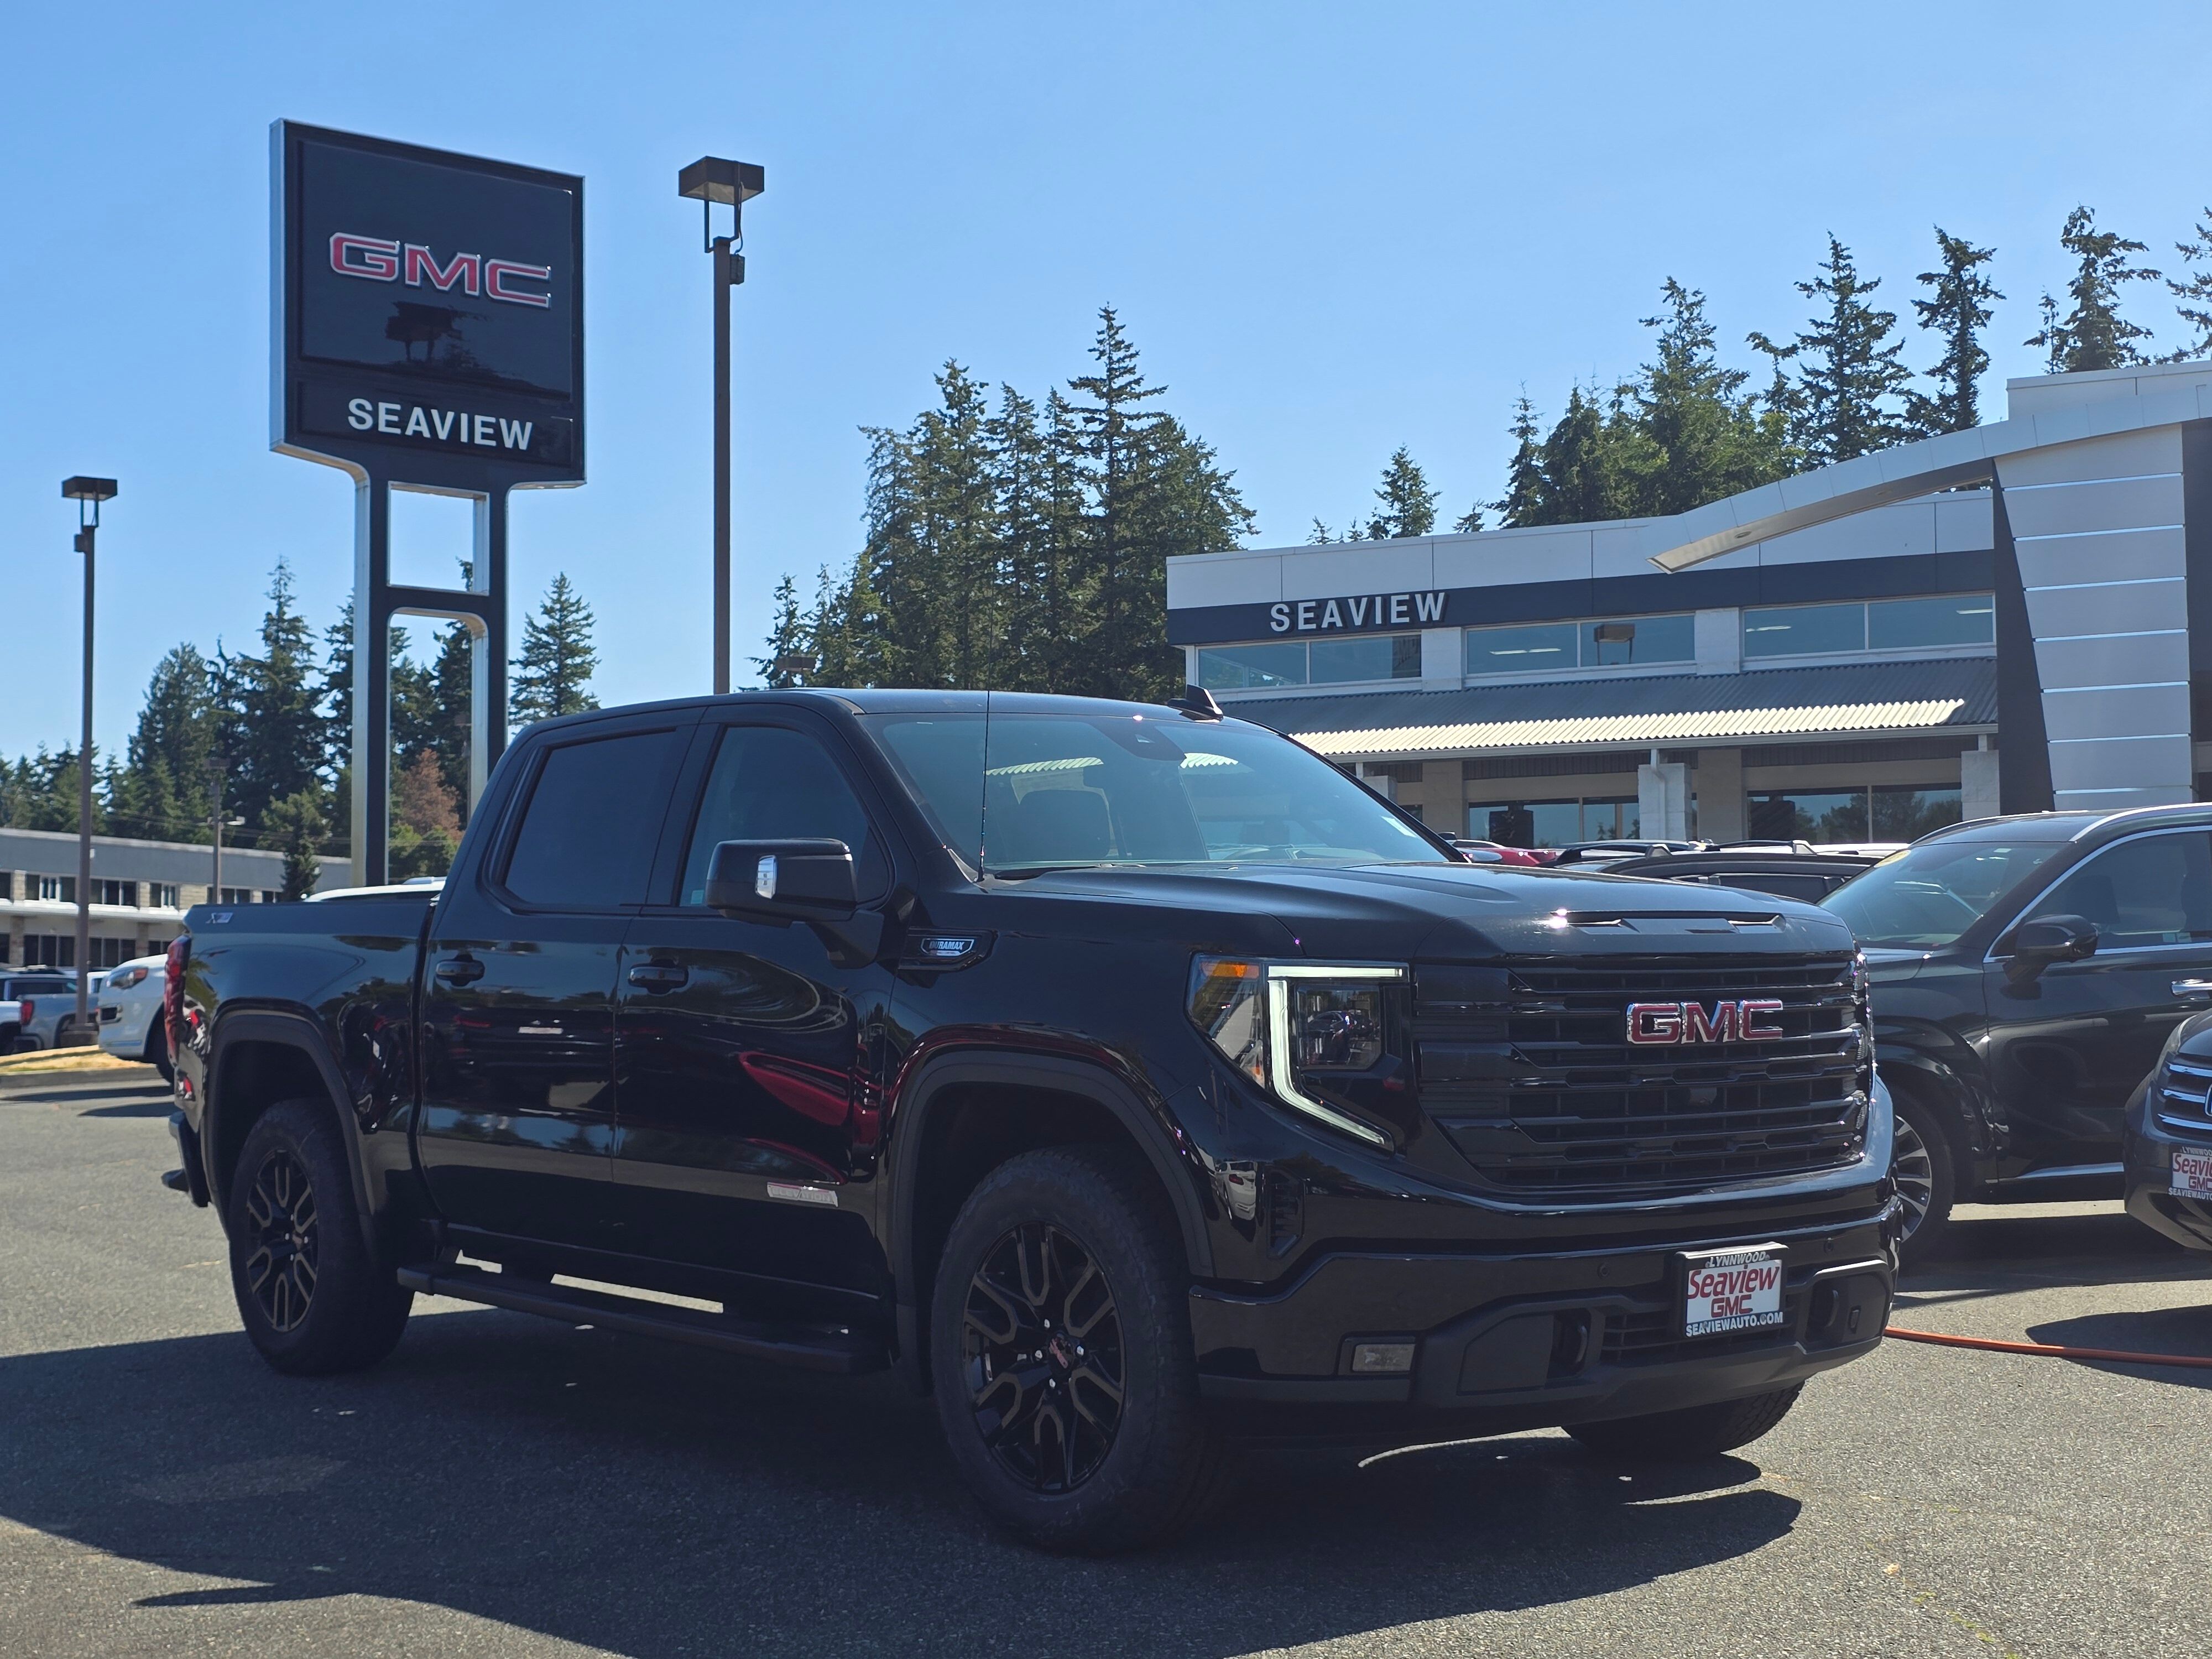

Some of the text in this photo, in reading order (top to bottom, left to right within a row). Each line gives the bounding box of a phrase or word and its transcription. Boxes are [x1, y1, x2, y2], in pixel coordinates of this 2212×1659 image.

[330, 232, 551, 308] GMC
[348, 398, 532, 450] SEAVIEW
[1270, 592, 1446, 632] SEAVIEW
[929, 941, 964, 950] DURAMAX
[1626, 999, 1783, 1044] GMC
[772, 1188, 830, 1201] ELEVATION
[2188, 1176, 2212, 1192] GMC
[1709, 1251, 1766, 1267] LYNNWOOD
[1687, 1264, 1780, 1299] Seaview
[1711, 1294, 1753, 1318] GMC
[1686, 1312, 1783, 1337] SEAVIEWAUTO.COM
